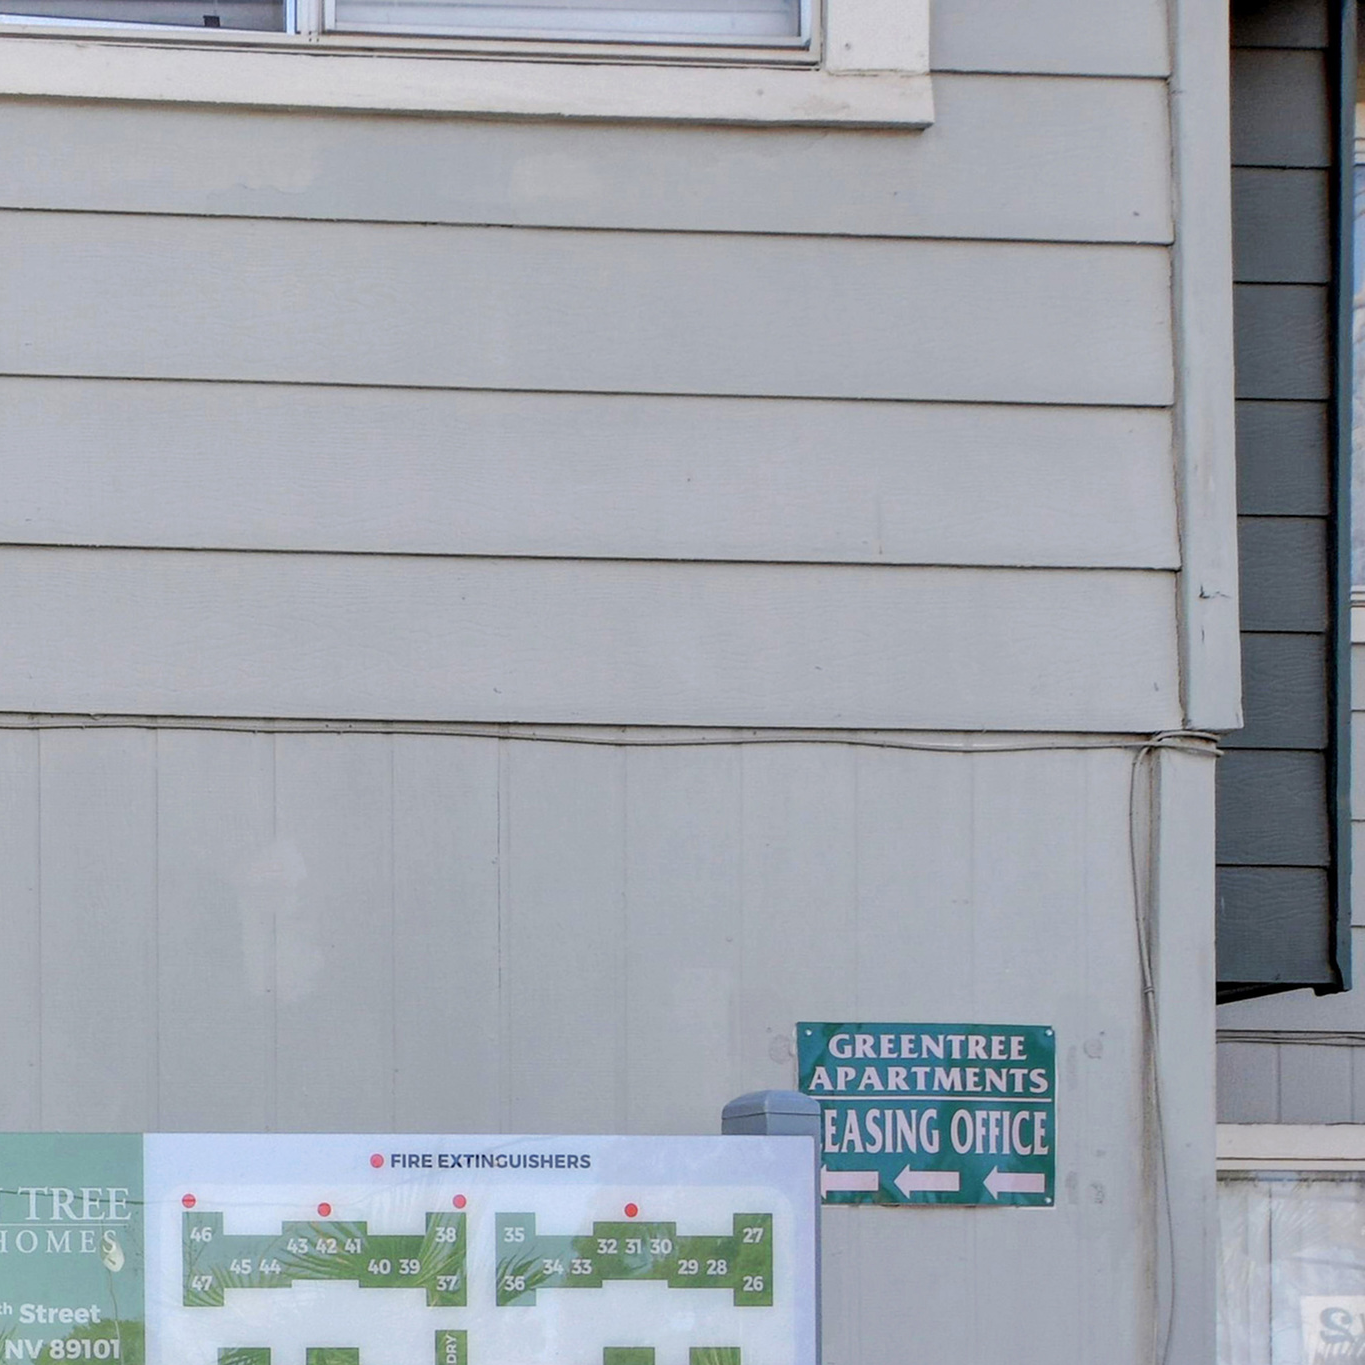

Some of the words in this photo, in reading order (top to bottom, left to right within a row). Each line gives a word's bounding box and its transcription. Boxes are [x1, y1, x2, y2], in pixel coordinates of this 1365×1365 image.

[828, 1033, 1027, 1060] GREENTREE
[809, 1066, 1048, 1093] APARTMENTS
[820, 1108, 940, 1154] EASING
[950, 1109, 1049, 1155] OFFICE
[391, 1153, 432, 1169] FIRE
[438, 1154, 591, 1169] EXTINGUISHERS
[17, 1186, 131, 1221] TREE
[190, 1227, 212, 1243] 46
[435, 1227, 456, 1243] 38
[504, 1227, 525, 1242] 35
[743, 1228, 764, 1243] 27
[287, 1238, 308, 1254] 43
[316, 1238, 337, 1254] 42
[345, 1238, 362, 1254] 41
[598, 1239, 618, 1254] 32
[625, 1239, 642, 1254] 31
[650, 1239, 672, 1254] 30
[230, 1259, 251, 1274] 45
[259, 1259, 281, 1274] 44
[368, 1259, 391, 1274] 40
[399, 1259, 420, 1274] 39
[543, 1259, 564, 1274] 34
[572, 1259, 592, 1274] 33
[678, 1259, 698, 1275] 29
[706, 1259, 727, 1275] 28
[192, 1275, 213, 1291] 47
[437, 1275, 457, 1291] 37
[505, 1276, 525, 1291] 36
[743, 1276, 764, 1291] 26
[19, 1303, 101, 1324] Street
[5, 1340, 44, 1359] NV
[49, 1339, 120, 1360] 89101
